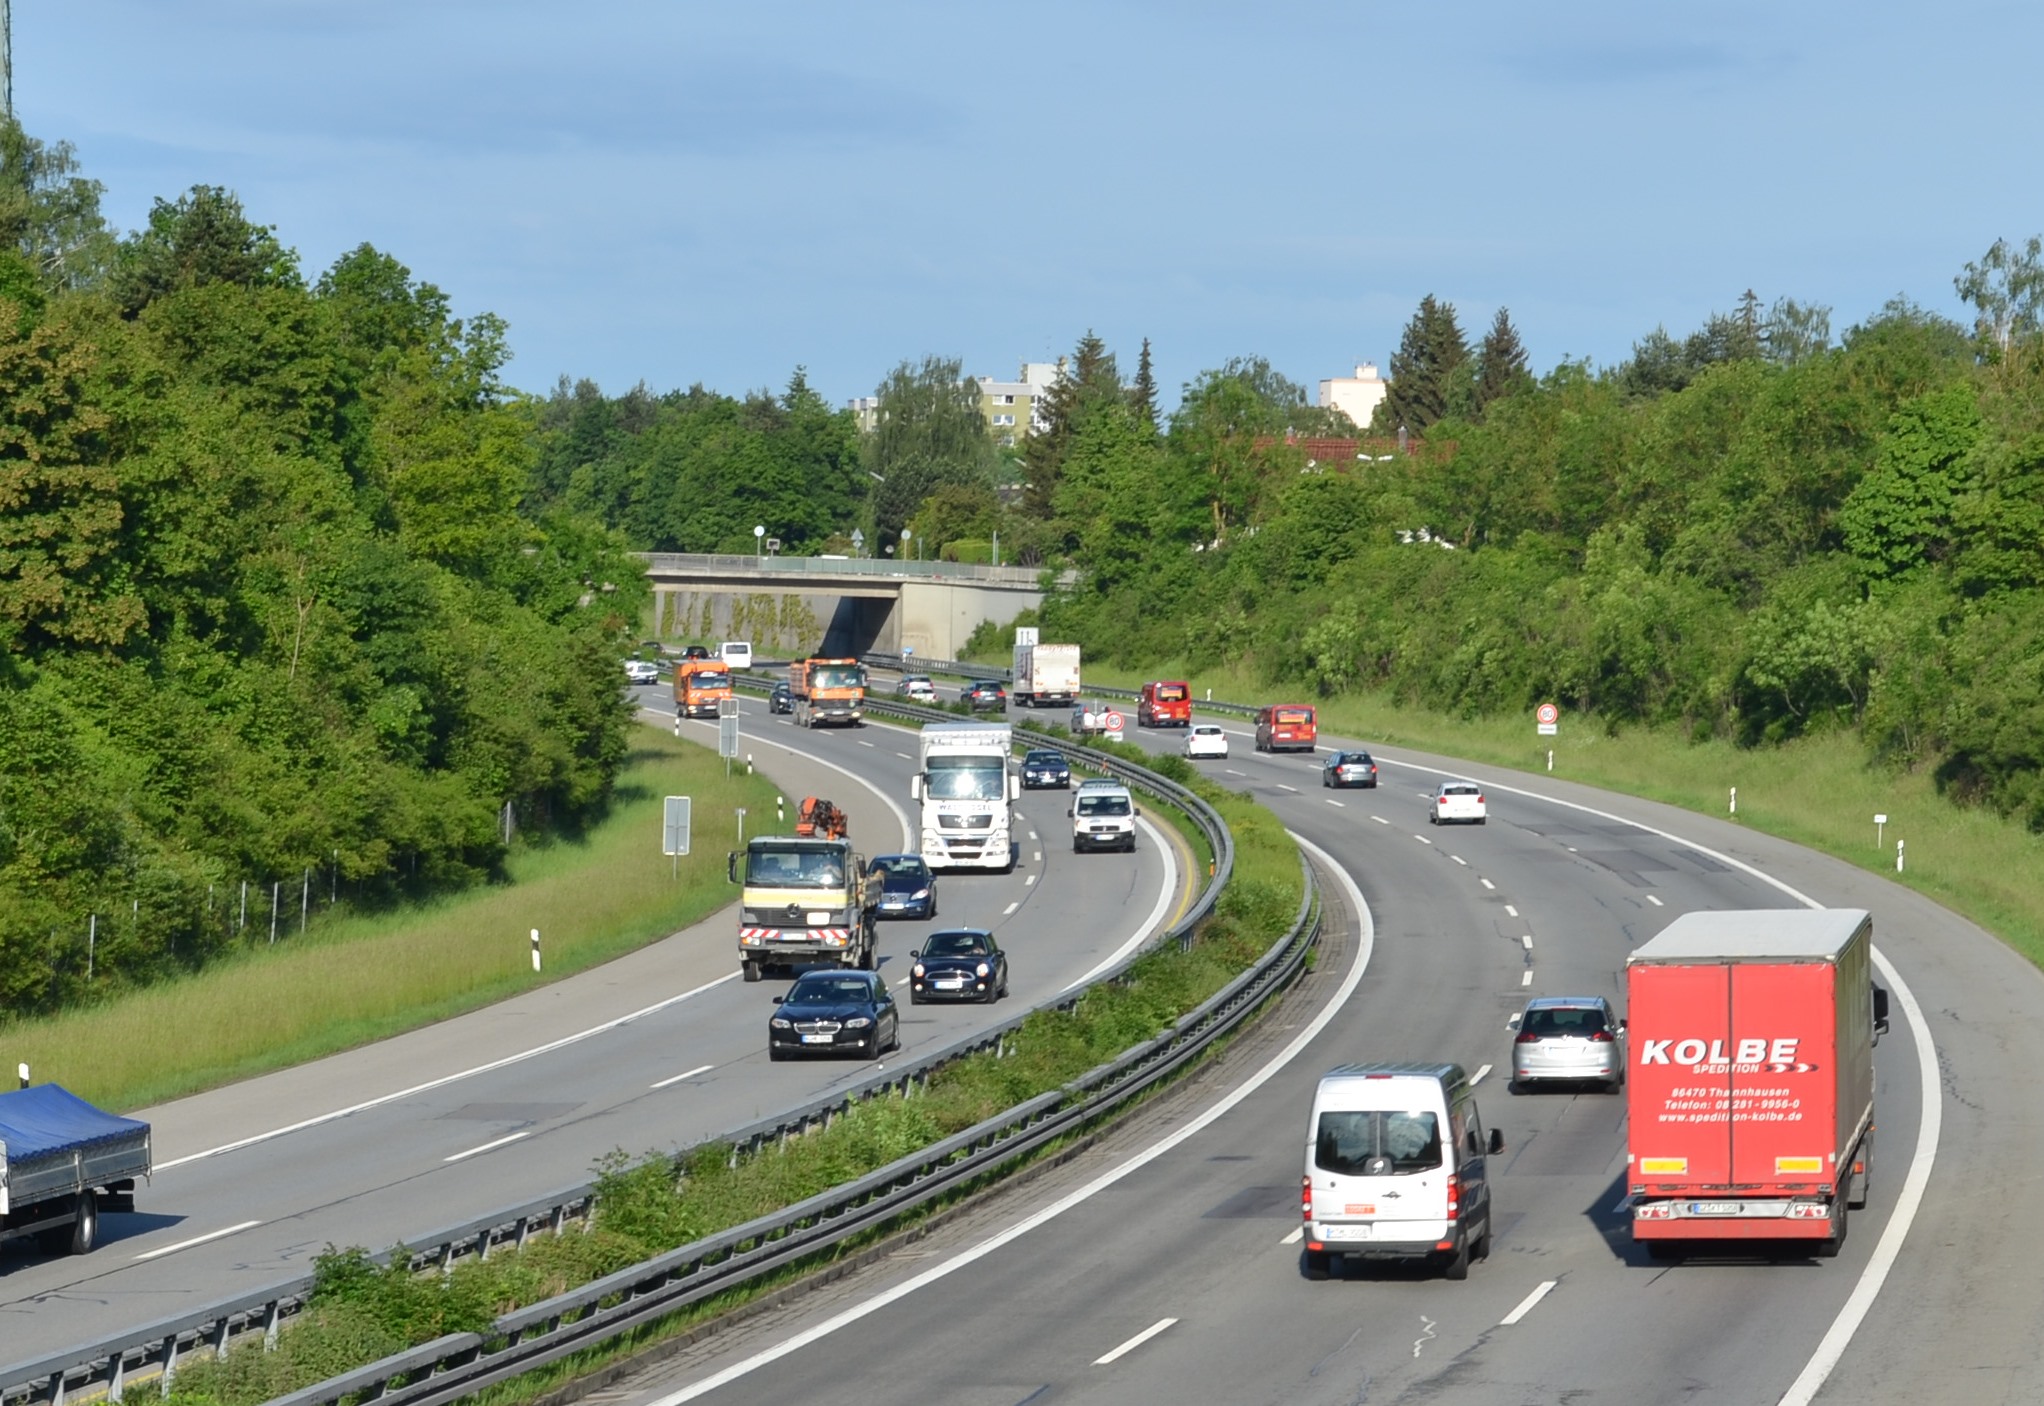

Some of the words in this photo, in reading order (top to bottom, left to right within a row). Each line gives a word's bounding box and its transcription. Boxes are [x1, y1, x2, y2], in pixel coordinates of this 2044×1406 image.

[1543, 710, 1552, 718] 80
[1109, 716, 1120, 726] 80
[1640, 1038, 1800, 1065] KOLBE
[1692, 1063, 1760, 1074] SPEDITION
[1709, 1087, 1790, 1097] Thannhausen
[1664, 1100, 1712, 1110] Telefon:
[1658, 1112, 1803, 1123] www.spedition-kolbe.de
